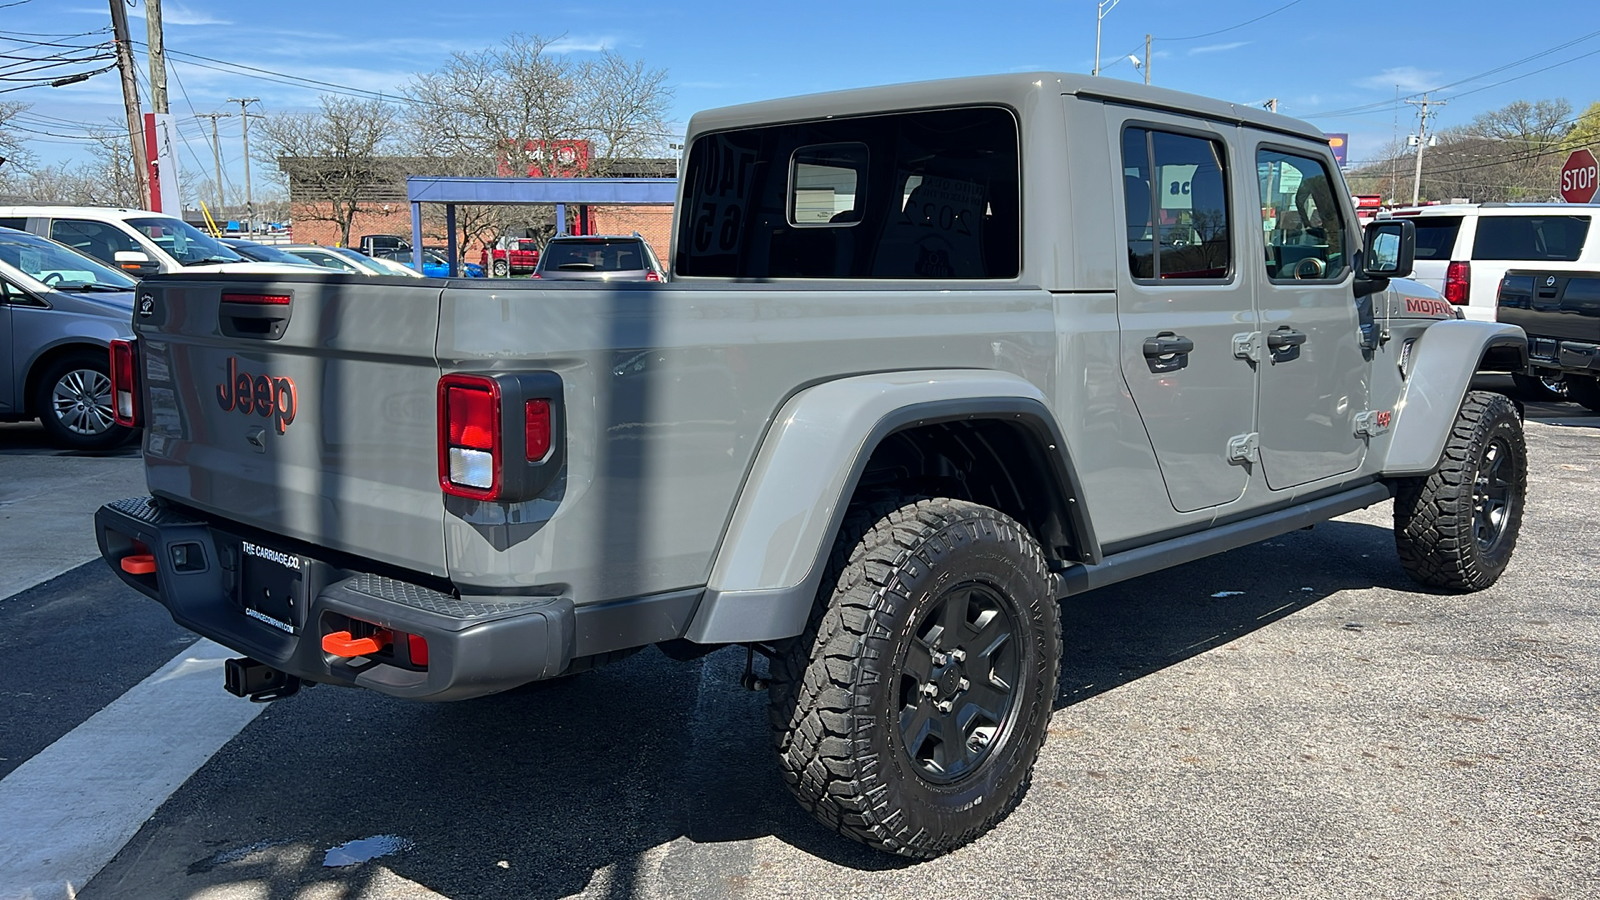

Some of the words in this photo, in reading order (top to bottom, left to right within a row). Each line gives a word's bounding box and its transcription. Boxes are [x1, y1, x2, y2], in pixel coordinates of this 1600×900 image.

[1562, 165, 1597, 192] STOP
[1404, 297, 1456, 316] MOJAVE
[215, 356, 298, 436] Jeep
[242, 540, 255, 555] THE
[255, 545, 288, 566] CARRIAGE
[245, 607, 295, 634] CARRIAGECOMPANY.COM
